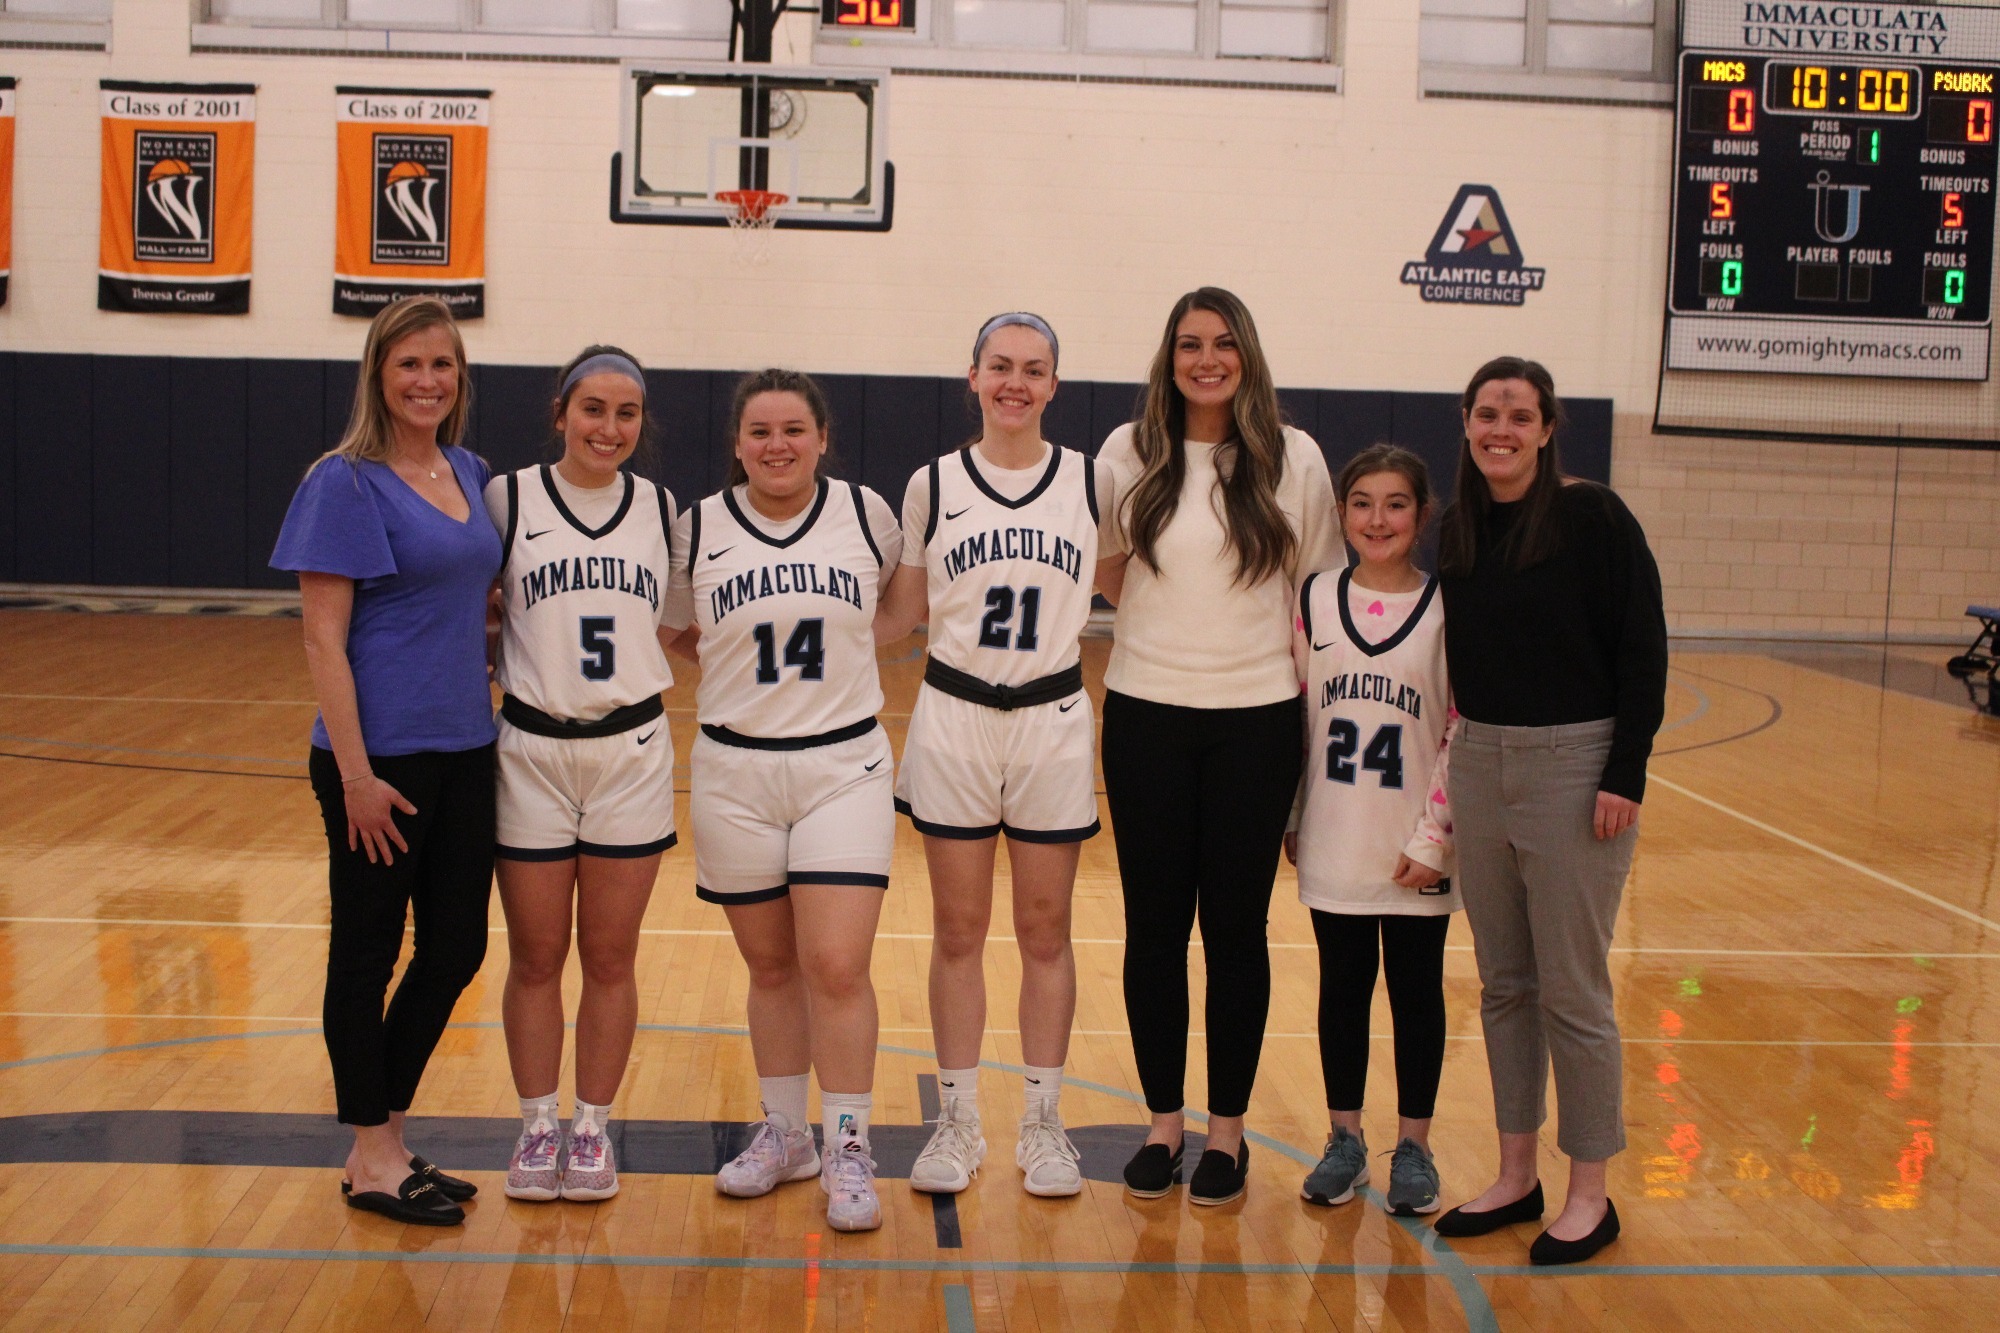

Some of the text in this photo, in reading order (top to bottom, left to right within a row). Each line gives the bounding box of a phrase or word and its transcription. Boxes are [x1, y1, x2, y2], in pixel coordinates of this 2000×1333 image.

[1744, 3, 1947, 31] IMMACULATA
[1744, 27, 1947, 54] UNIVERSITY
[1703, 61, 1746, 82] MACS
[1933, 71, 1993, 93] PSUBRK
[1792, 66, 1909, 112] 10:00
[110, 96, 241, 117] Class of 2001
[348, 99, 478, 120] Class of 2002
[1728, 89, 1754, 132] 0
[1812, 120, 1840, 133] POSS
[1967, 99, 1992, 142] 0
[141, 140, 209, 151] WOMEN'S
[379, 143, 445, 154] WOMEN'S
[1712, 139, 1759, 156] BONUS
[1801, 132, 1851, 150] PERIOD
[1871, 129, 1879, 163] 1
[1920, 148, 1966, 165] BONUS
[1688, 165, 1759, 183] TIMEOUTS
[1920, 175, 1990, 193] TIMEOUTS
[1711, 183, 1732, 218] 5
[1943, 193, 1963, 227] 5
[1702, 220, 1736, 236] LEFT
[1935, 229, 1968, 245] LEFT
[139, 245, 168, 254] HALL
[178, 246, 207, 255] FAME
[377, 247, 404, 257] HALL
[414, 248, 442, 258] FAME
[1699, 242, 1744, 259] FOULS
[1787, 246, 1892, 265] PLAYER FOULS
[1923, 252, 1967, 268] FOULS
[1405, 265, 1543, 287] ATLANTIC EAST
[1722, 261, 1743, 296] 0
[131, 287, 216, 302] Theresa Grentz
[340, 289, 390, 303] Marianne
[1424, 285, 1522, 303] CONFERENCE
[1944, 270, 1965, 304] 0
[1706, 297, 1736, 312] WON
[1927, 306, 1956, 320] WON
[1697, 335, 1961, 363] www.gomightymacs.com
[943, 528, 1082, 585] IMMACULATA
[521, 556, 659, 613] IMMACULATA
[711, 563, 863, 625] IMMACULATA
[978, 584, 1042, 652] 21
[579, 615, 616, 682] 5
[752, 617, 825, 685] 14
[1321, 673, 1422, 720] IMMACULATA
[1326, 717, 1403, 790] 24
